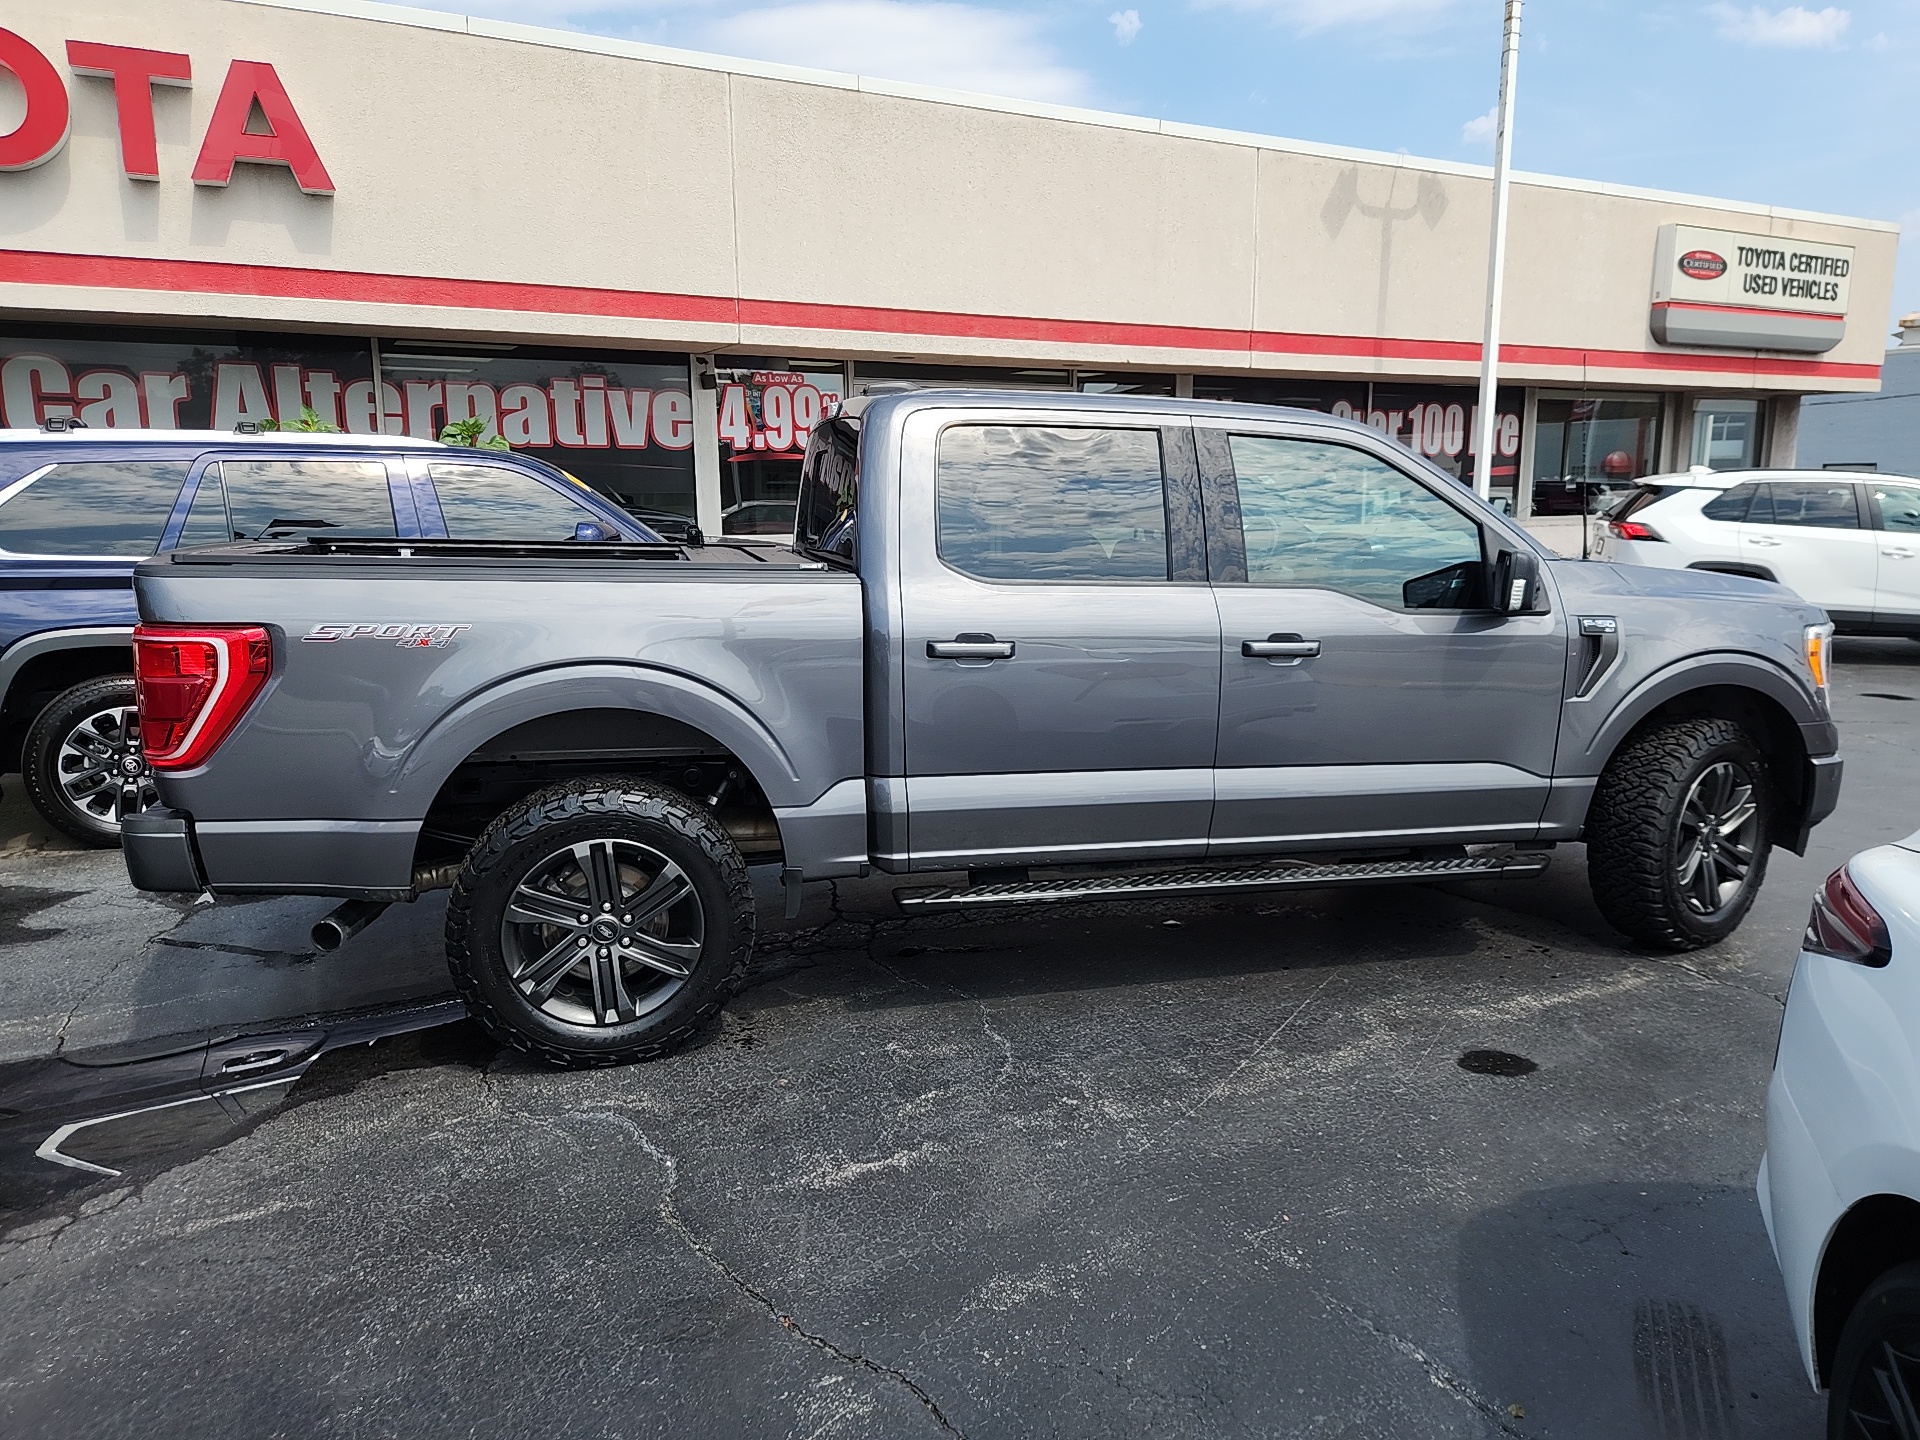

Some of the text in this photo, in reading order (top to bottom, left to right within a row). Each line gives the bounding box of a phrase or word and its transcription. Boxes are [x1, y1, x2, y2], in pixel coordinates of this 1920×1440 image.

[1737, 246, 1849, 278] TOYOTA CERTIFIED
[1743, 273, 1839, 302] USED VEHICLES
[754, 373, 767, 382] As
[769, 374, 788, 383] Low
[1, 352, 693, 450] Car Alternative
[1407, 402, 1464, 457] 100
[301, 622, 472, 642] SPORT
